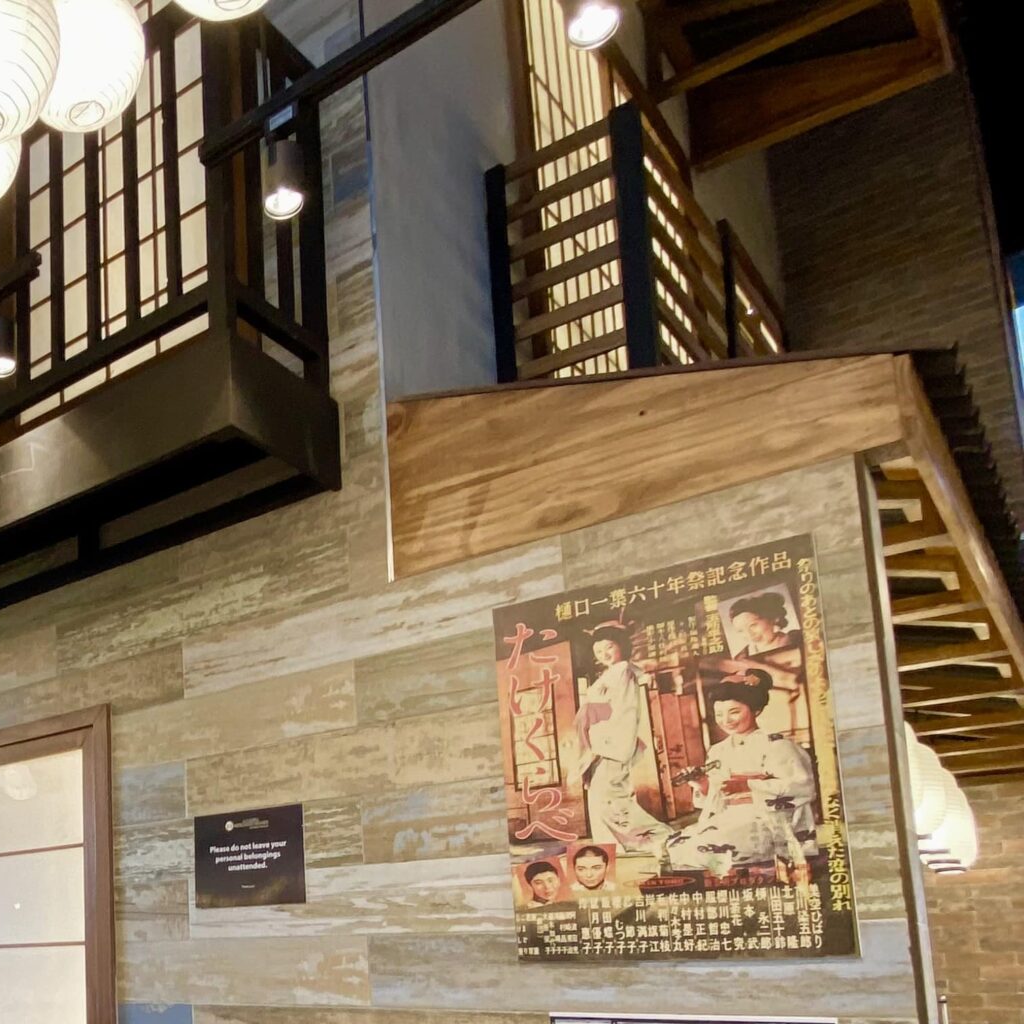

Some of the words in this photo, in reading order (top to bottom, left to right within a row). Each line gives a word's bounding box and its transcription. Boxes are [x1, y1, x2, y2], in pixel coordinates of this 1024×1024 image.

[554, 551, 792, 622] 樋口一葉六十年祭記念作品
[503, 622, 578, 842] たけくらべ
[209, 845, 230, 853] Please
[231, 843, 239, 851] do
[240, 842, 252, 850] not
[252, 841, 270, 849] leave
[271, 840, 287, 849] your
[215, 854, 243, 864] personal
[244, 851, 281, 861] belongings
[228, 862, 268, 871] unattended.
